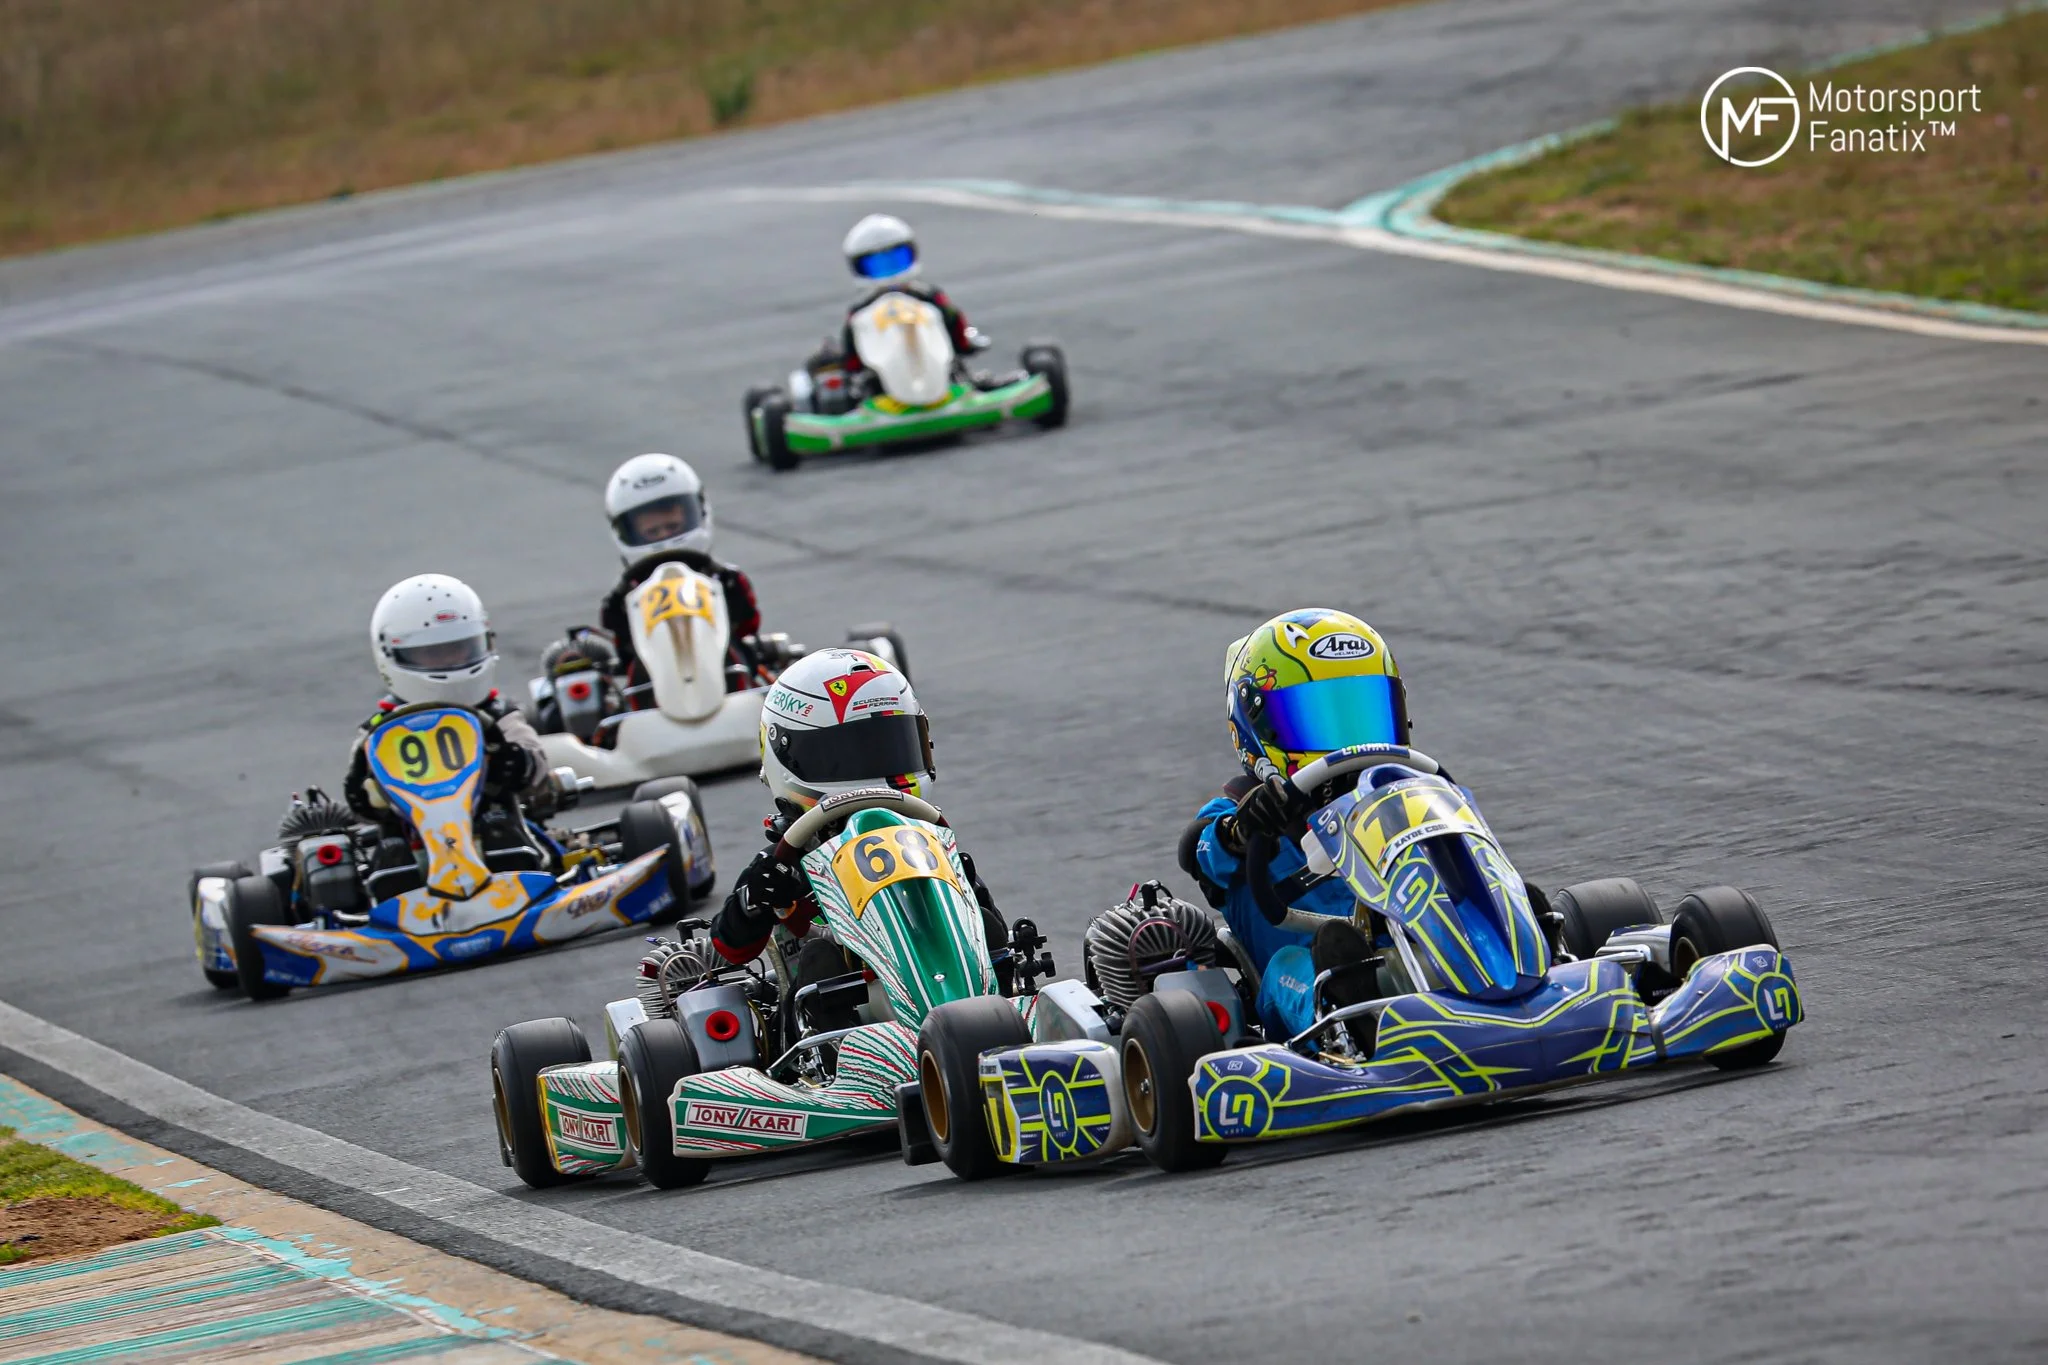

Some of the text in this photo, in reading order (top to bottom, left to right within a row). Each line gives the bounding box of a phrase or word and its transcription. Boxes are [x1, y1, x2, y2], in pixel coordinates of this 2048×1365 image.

[1315, 636, 1368, 656] Arai
[399, 726, 466, 778] 90
[853, 828, 939, 883] 68
